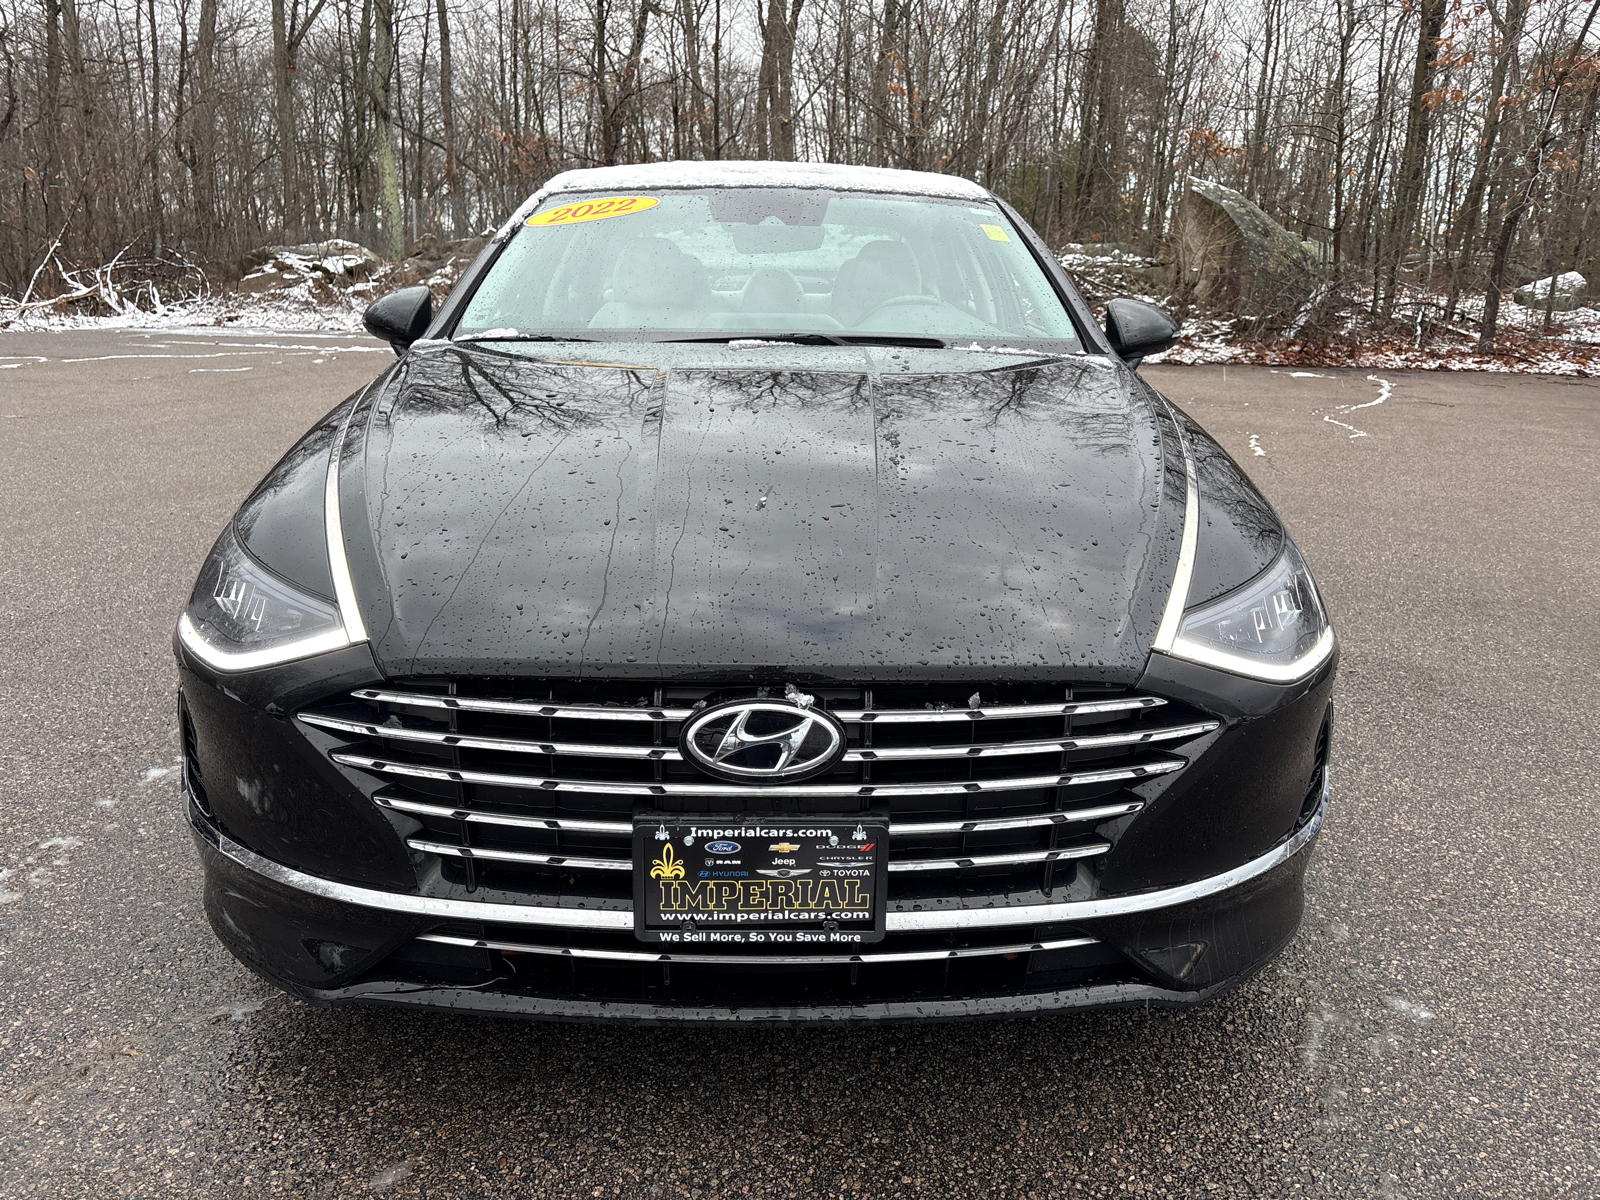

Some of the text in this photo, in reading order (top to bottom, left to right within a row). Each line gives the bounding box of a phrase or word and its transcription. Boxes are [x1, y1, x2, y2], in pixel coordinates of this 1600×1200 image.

[547, 198, 638, 224] 2022
[690, 826, 832, 839] Imperialcars.com
[771, 857, 796, 867] Jeep
[832, 869, 871, 877] TOYOTA
[659, 879, 870, 910] IMPERIAL
[660, 910, 869, 922] www.imperialcars.com
[659, 932, 861, 943] We Sell More, So You Save More
